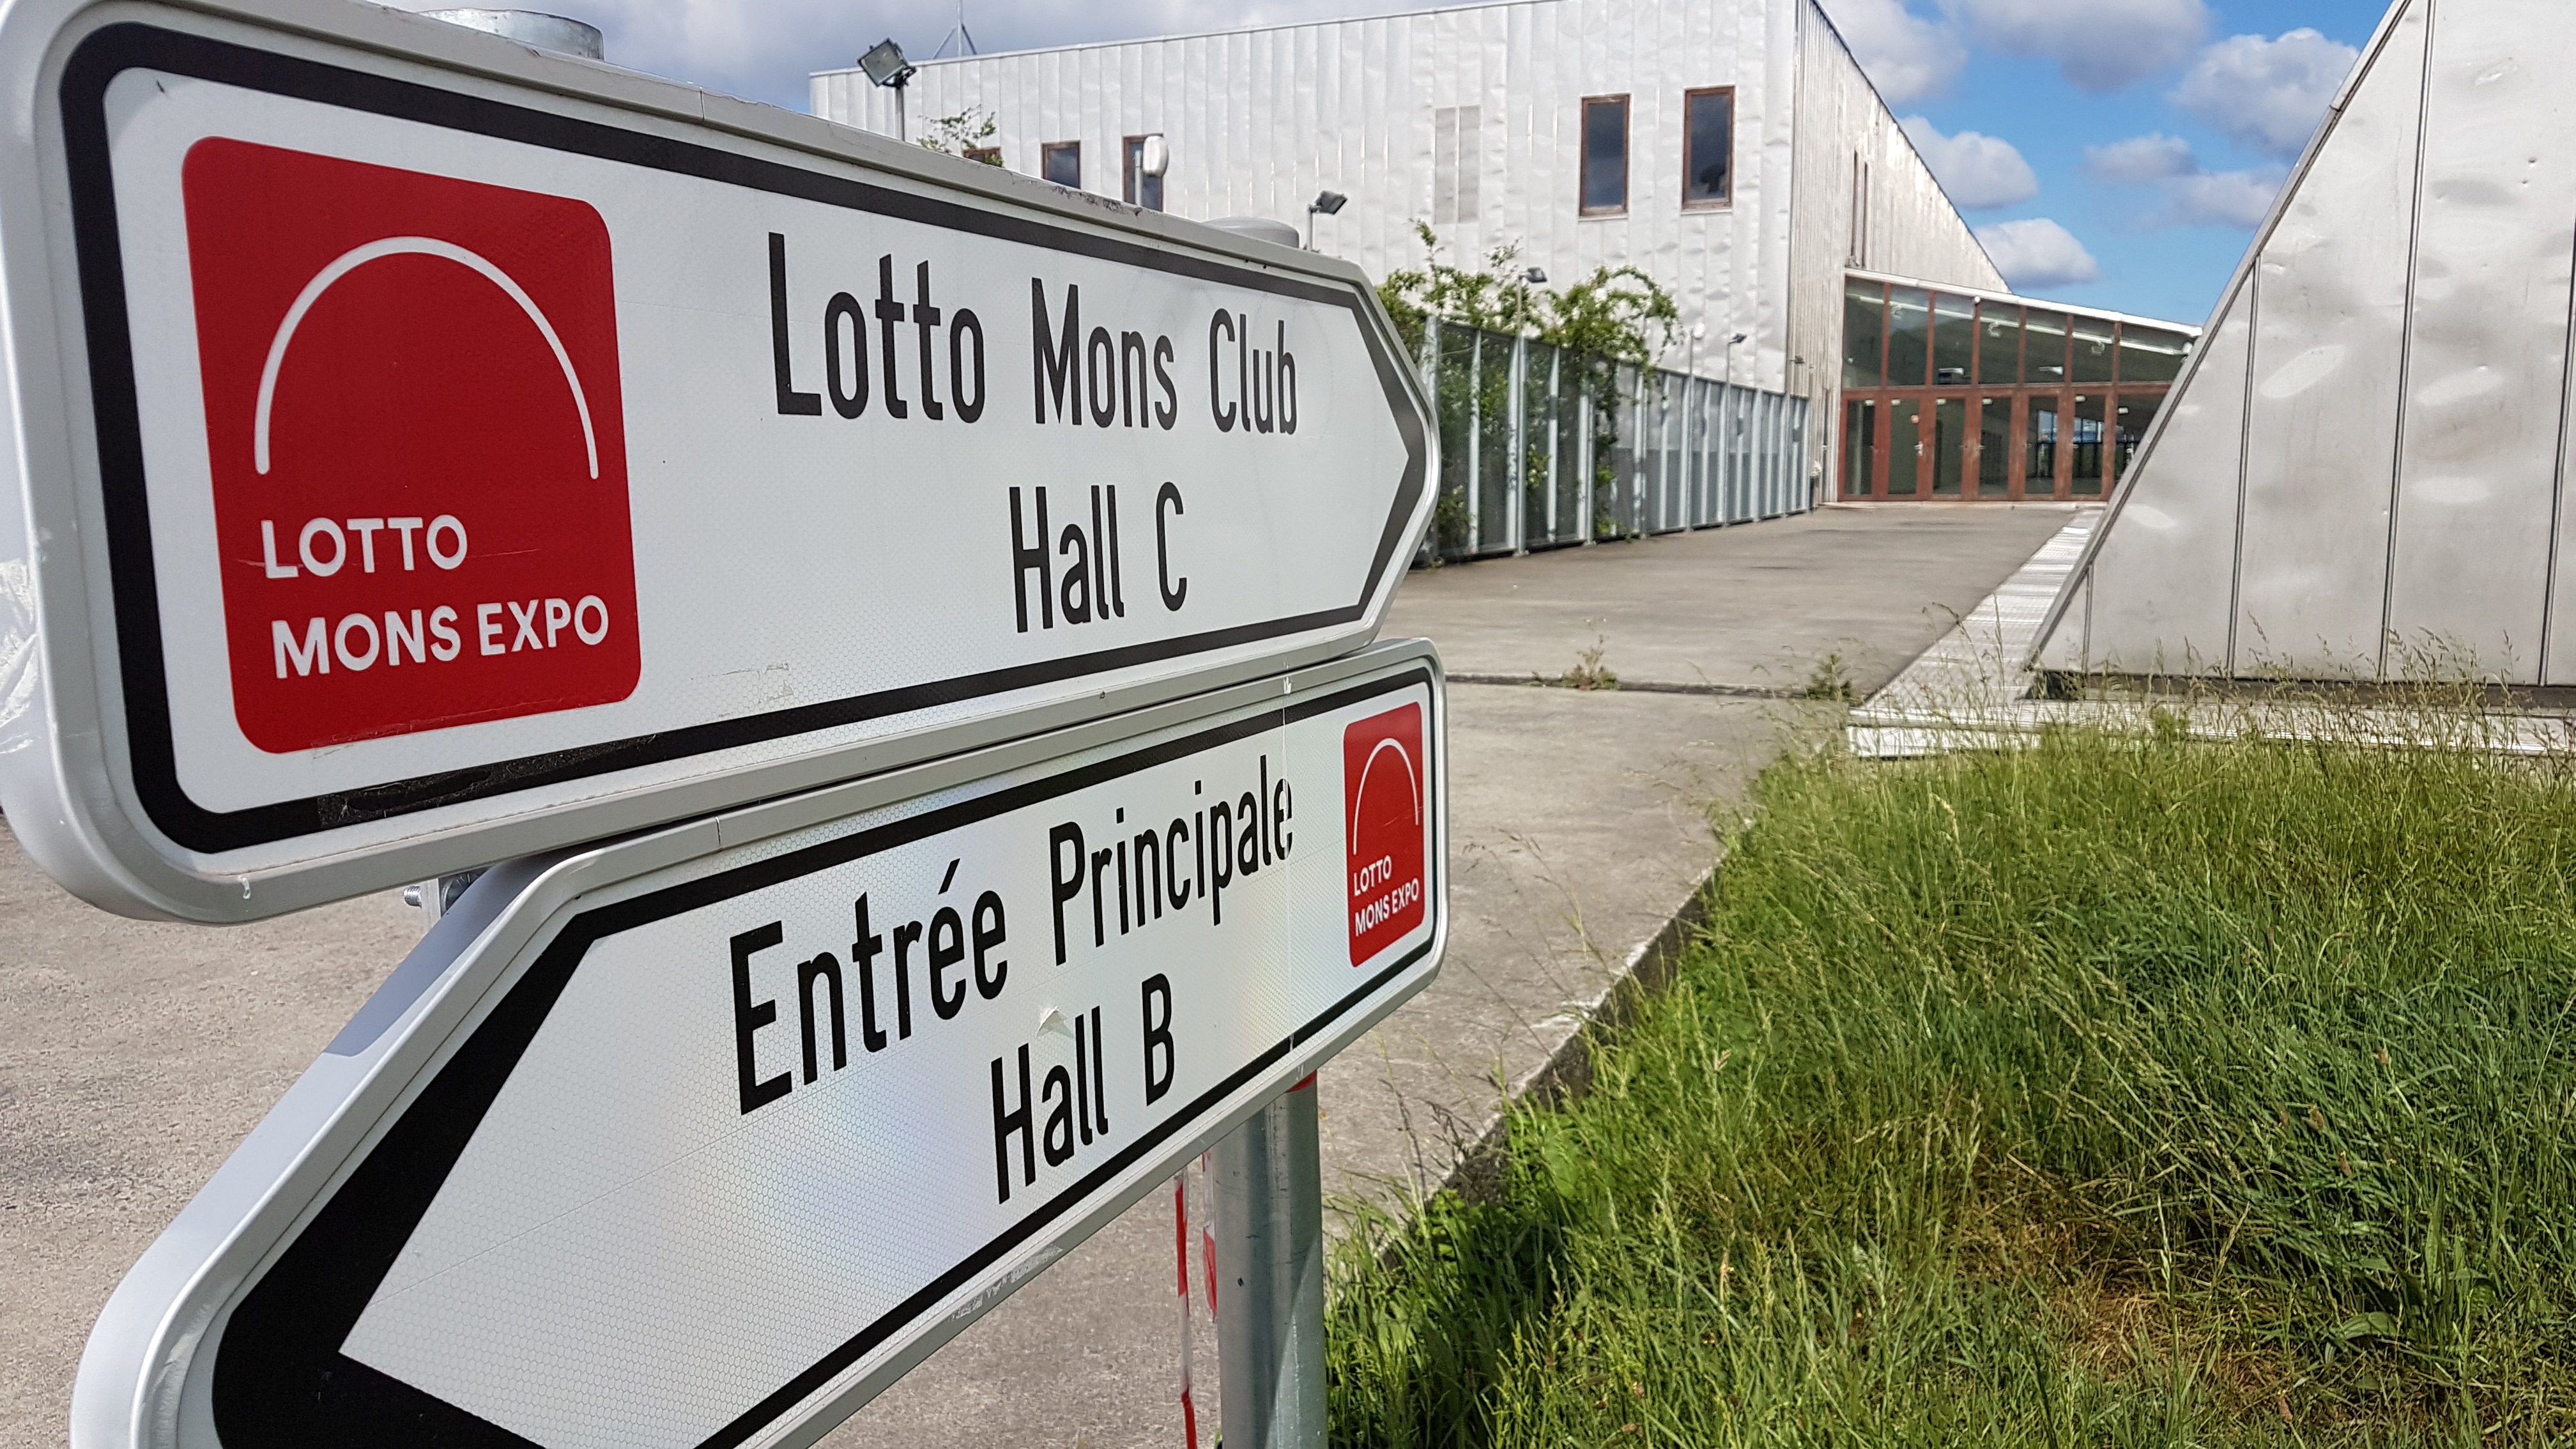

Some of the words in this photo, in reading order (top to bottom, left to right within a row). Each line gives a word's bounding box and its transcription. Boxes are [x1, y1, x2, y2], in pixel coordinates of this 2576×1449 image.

[769, 232, 985, 423] Lotto
[1032, 277, 1177, 431] Mons
[1209, 308, 1297, 435] Club
[261, 514, 468, 579] LOTTO
[1009, 485, 1124, 633] Hall
[1156, 482, 1187, 611] C
[272, 604, 462, 680] MONS
[477, 595, 610, 657] EXPO
[1353, 855, 1392, 896] LOTTO
[1354, 894, 1391, 937] MONS
[1392, 878, 1420, 914] EXPO
[730, 858, 1008, 1116] Entrée
[1049, 755, 1292, 967] Principale
[991, 1005, 1108, 1205] Hall
[1141, 973, 1175, 1107] B
